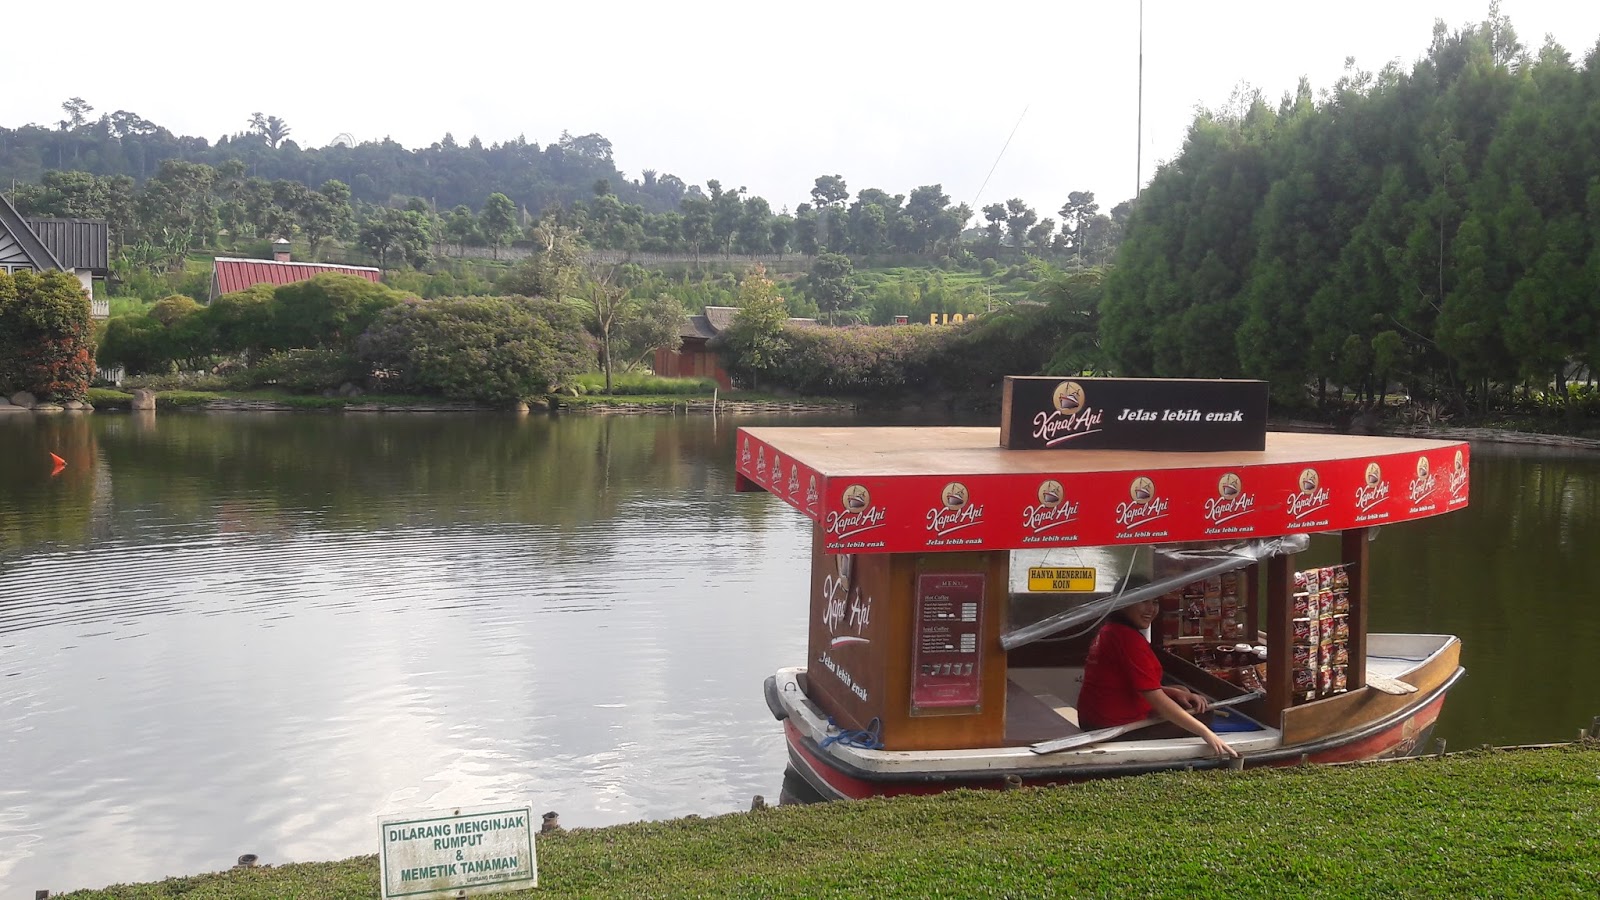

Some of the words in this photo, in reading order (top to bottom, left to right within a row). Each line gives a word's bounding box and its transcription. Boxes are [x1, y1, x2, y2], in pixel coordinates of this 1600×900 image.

[1033, 410, 1075, 440] Kapal
[1074, 407, 1103, 430] Api
[1118, 408, 1158, 420] Jelas
[1162, 409, 1201, 421] lebih
[1206, 409, 1244, 421] enak
[1023, 504, 1056, 528] Kapal
[1056, 501, 1078, 520] Api
[1116, 500, 1148, 525] Kapal
[1147, 497, 1168, 515] Api
[1205, 497, 1236, 520] Kapal
[1235, 493, 1254, 511] Api
[1287, 492, 1313, 516] Kapal
[1312, 488, 1329, 506] Api
[826, 510, 862, 534] Kapal
[862, 506, 886, 525] Api
[926, 506, 961, 532] Kapal
[960, 504, 984, 522] Api
[1031, 570, 1054, 578] HANYA
[1056, 570, 1092, 579] MENERIMA
[1053, 580, 1070, 589] KOIN
[850, 587, 872, 635] Api
[819, 652, 835, 672] Jelas
[836, 664, 851, 688] lebih
[852, 682, 867, 702] enak
[390, 824, 451, 842] DILARANG
[455, 816, 524, 834] MENGINJAK
[434, 834, 483, 850] RUMPUT
[401, 864, 457, 882] MEMETIK
[460, 856, 518, 874] TANAMAN
[456, 850, 464, 861] &
